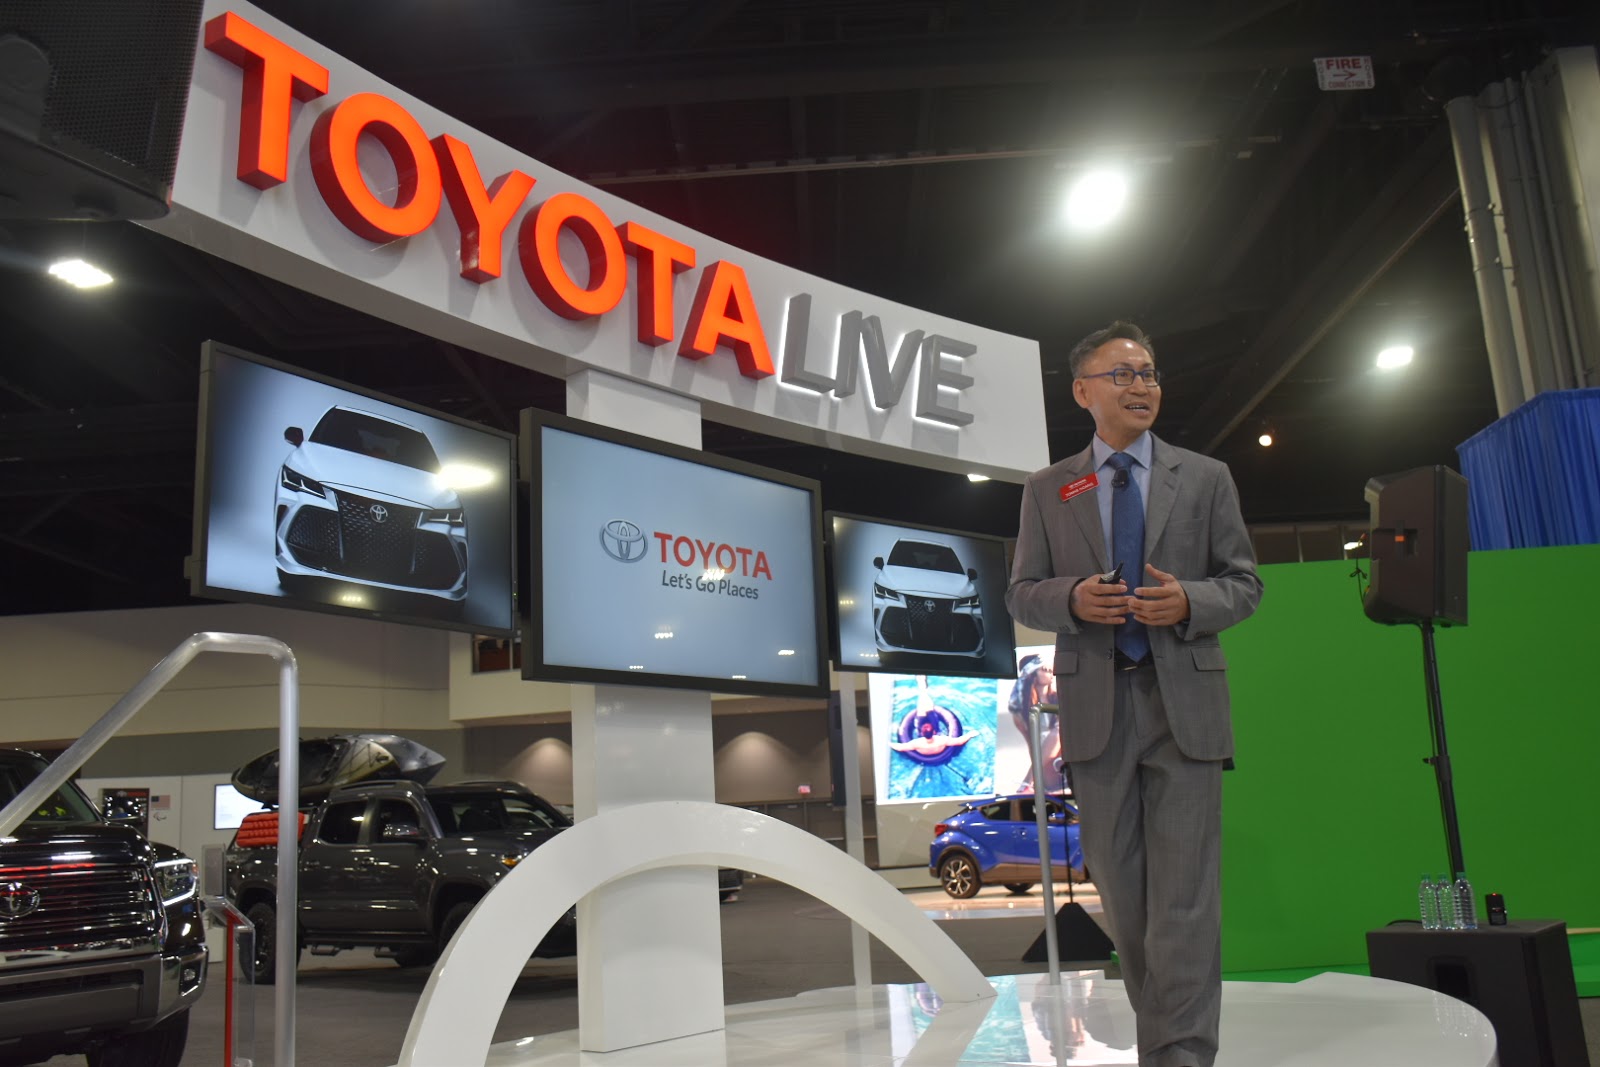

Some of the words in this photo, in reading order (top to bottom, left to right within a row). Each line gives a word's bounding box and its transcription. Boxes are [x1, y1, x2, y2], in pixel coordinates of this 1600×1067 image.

[1326, 58, 1362, 70] FIRE
[204, 11, 775, 380] TOYOTA
[779, 292, 978, 428] LIVE
[654, 531, 773, 581] TOYOTA
[661, 570, 693, 590] Let's
[695, 575, 716, 593] Go
[718, 579, 759, 600] Places
